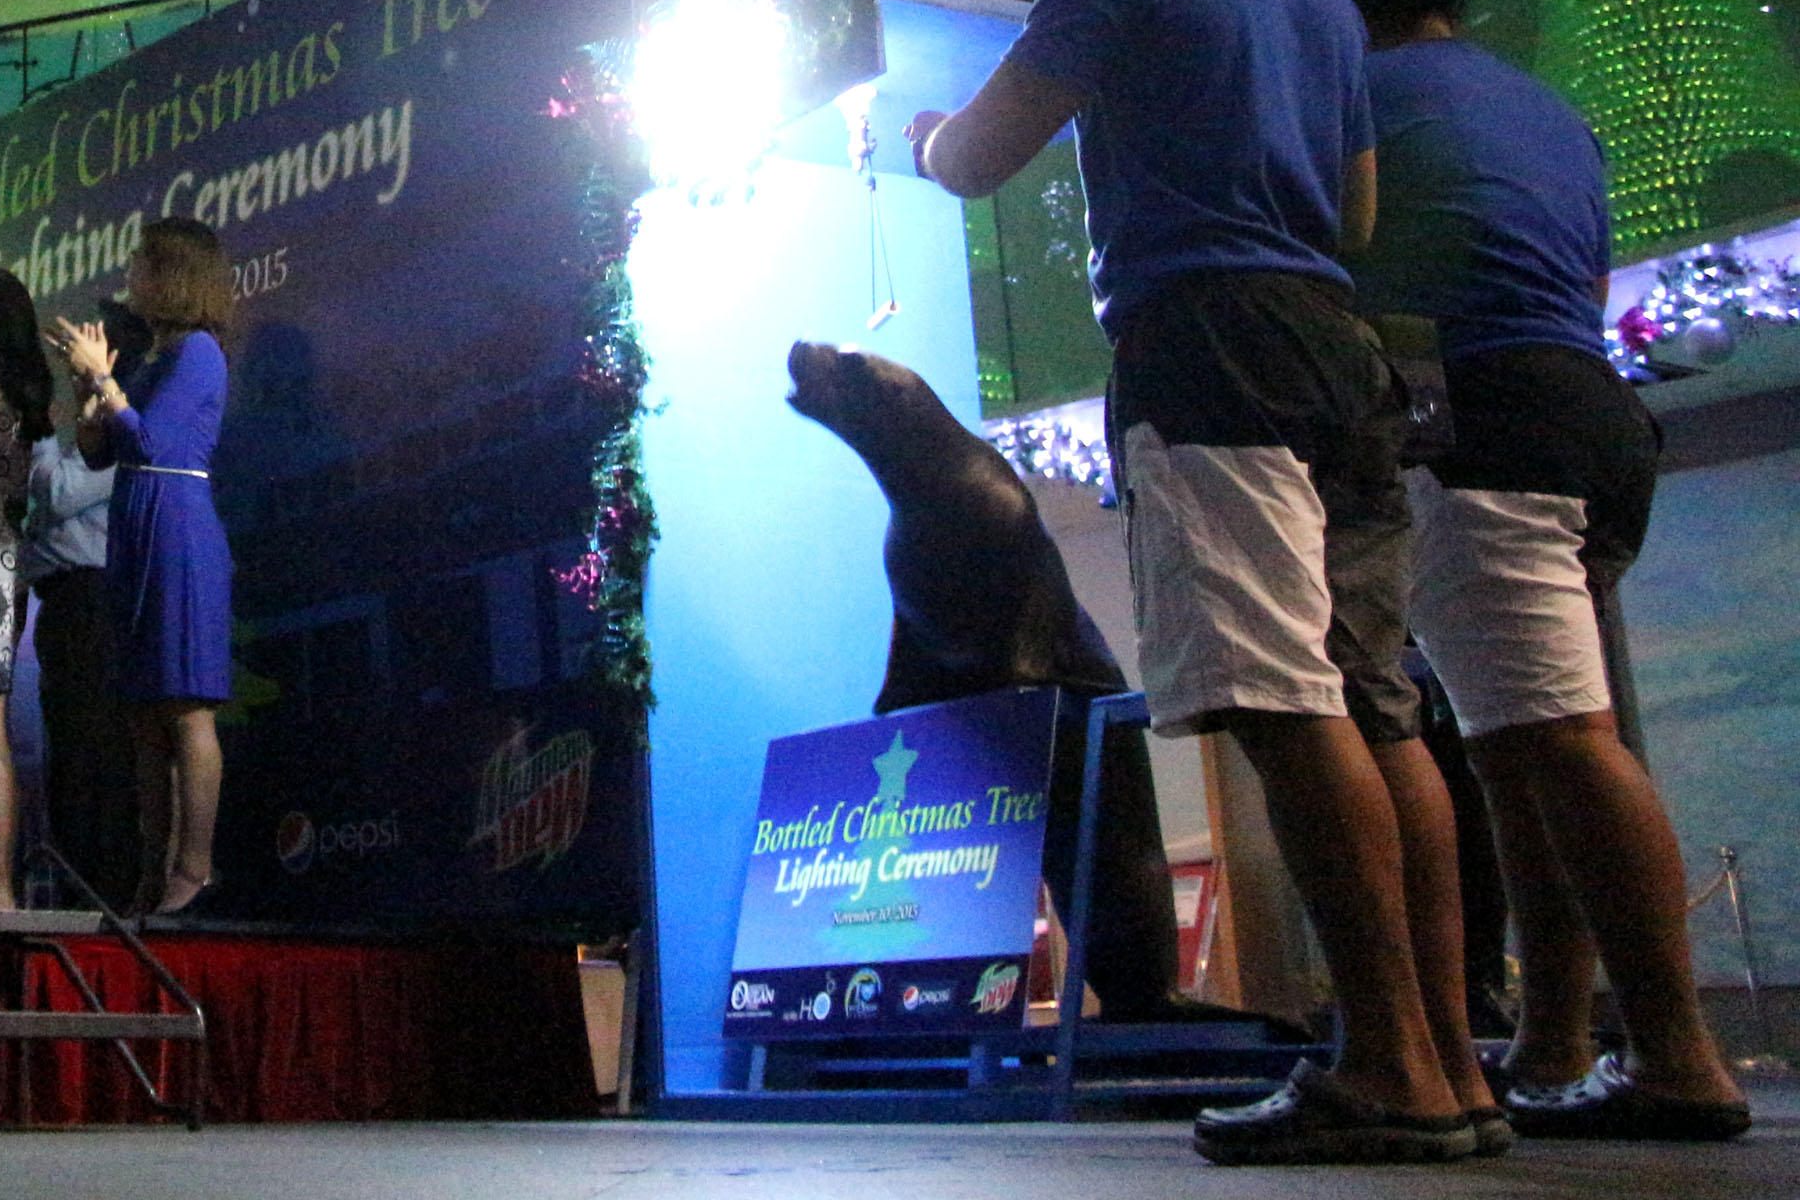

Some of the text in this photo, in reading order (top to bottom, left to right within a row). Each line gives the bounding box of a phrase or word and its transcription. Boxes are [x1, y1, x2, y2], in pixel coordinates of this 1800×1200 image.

[76, 21, 345, 188] Christmas
[162, 99, 413, 229] Ceremony
[231, 247, 288, 301] 2015
[318, 808, 400, 857] pepsi
[752, 785, 1045, 855] Bottled Christmas Tree
[773, 843, 1001, 907] Lighting Ceremony
